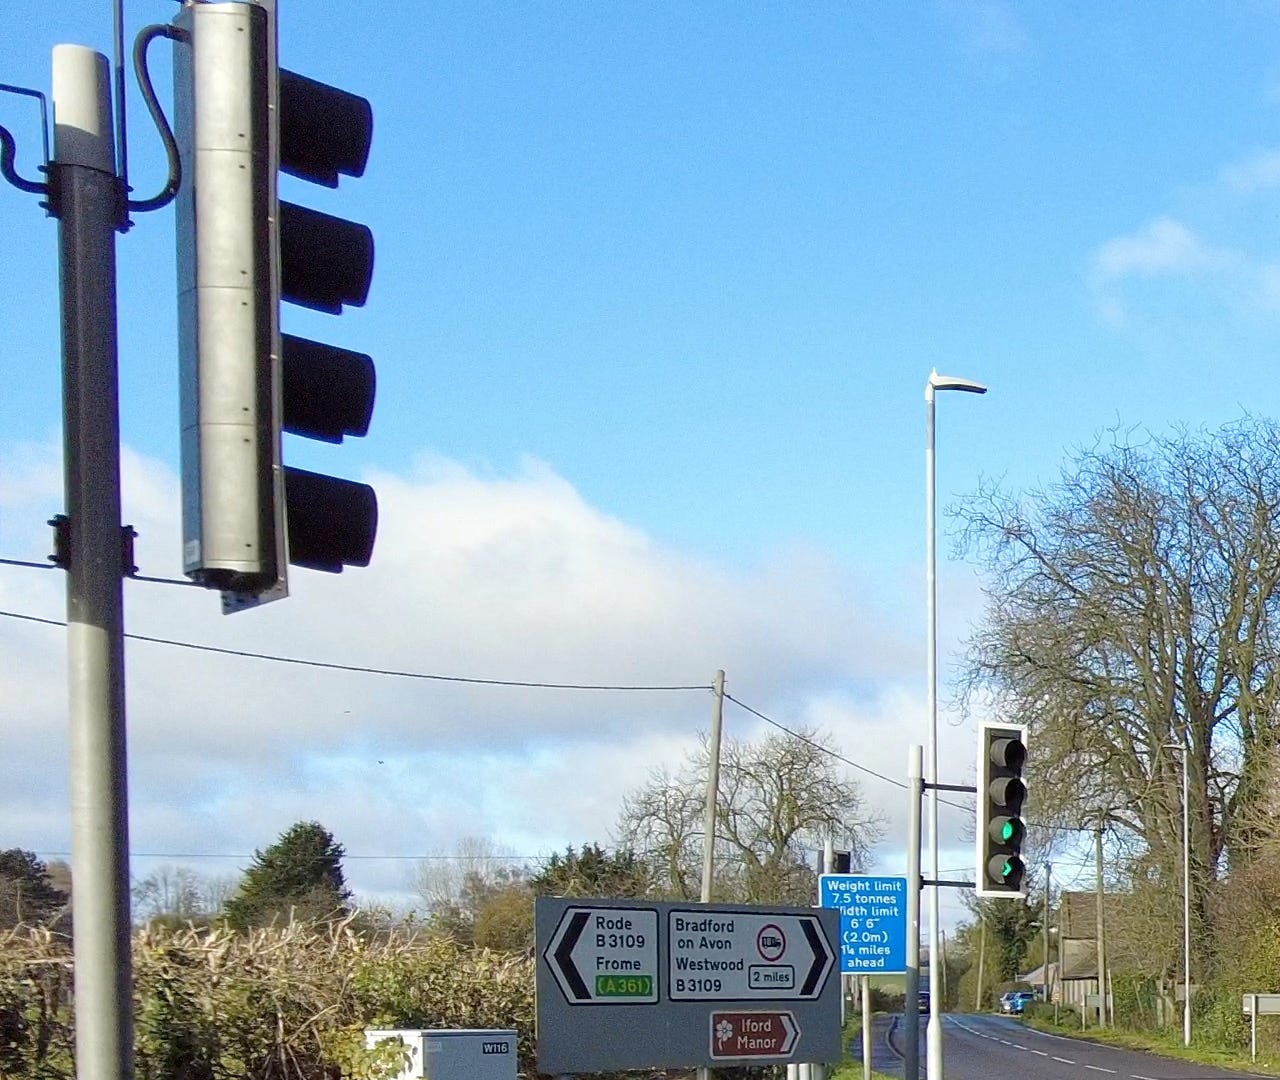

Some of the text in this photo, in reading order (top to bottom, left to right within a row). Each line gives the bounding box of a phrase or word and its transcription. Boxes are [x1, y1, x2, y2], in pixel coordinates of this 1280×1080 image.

[827, 881, 902, 893] Weight limit
[832, 893, 897, 904] 7.5 tonnes
[871, 906, 899, 917] limit
[596, 916, 632, 930] Rode
[675, 918, 735, 933] Bradford
[677, 937, 732, 950] on Avon
[843, 930, 889, 944] (2.0m)
[858, 944, 891, 955] miles
[596, 956, 641, 970] Frome
[676, 957, 744, 971] Westwood
[847, 957, 885, 968] ahead
[753, 971, 790, 982] 2 miles
[741, 1018, 772, 1032] Iford
[737, 1036, 777, 1050] Manor
